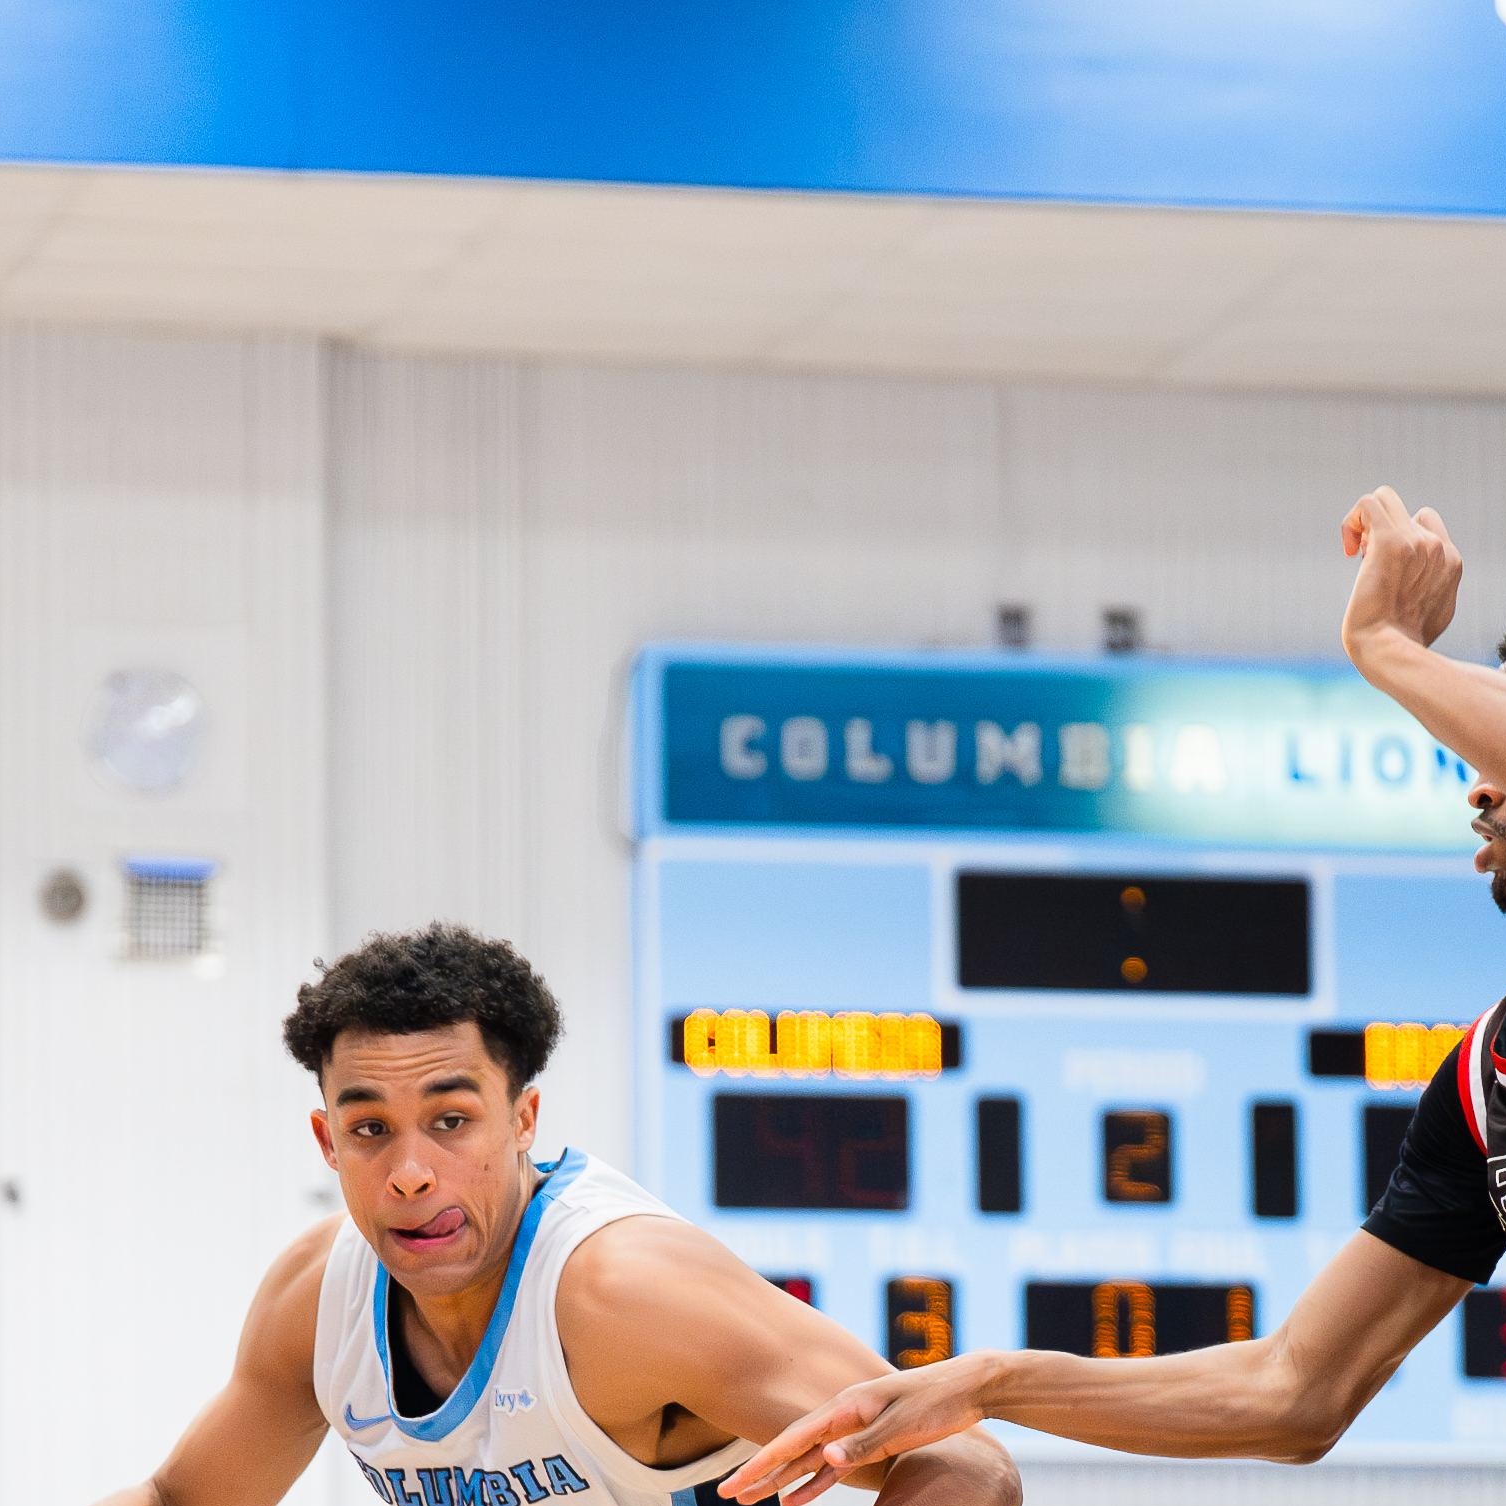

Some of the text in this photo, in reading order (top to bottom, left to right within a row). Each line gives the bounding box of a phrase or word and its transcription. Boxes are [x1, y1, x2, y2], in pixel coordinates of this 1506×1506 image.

[719, 713, 1473, 794] COLUMBIA LION
[1108, 1111, 1166, 1201] 2
[897, 1275, 953, 1369] 3
[495, 1389, 516, 1413] Ivy
